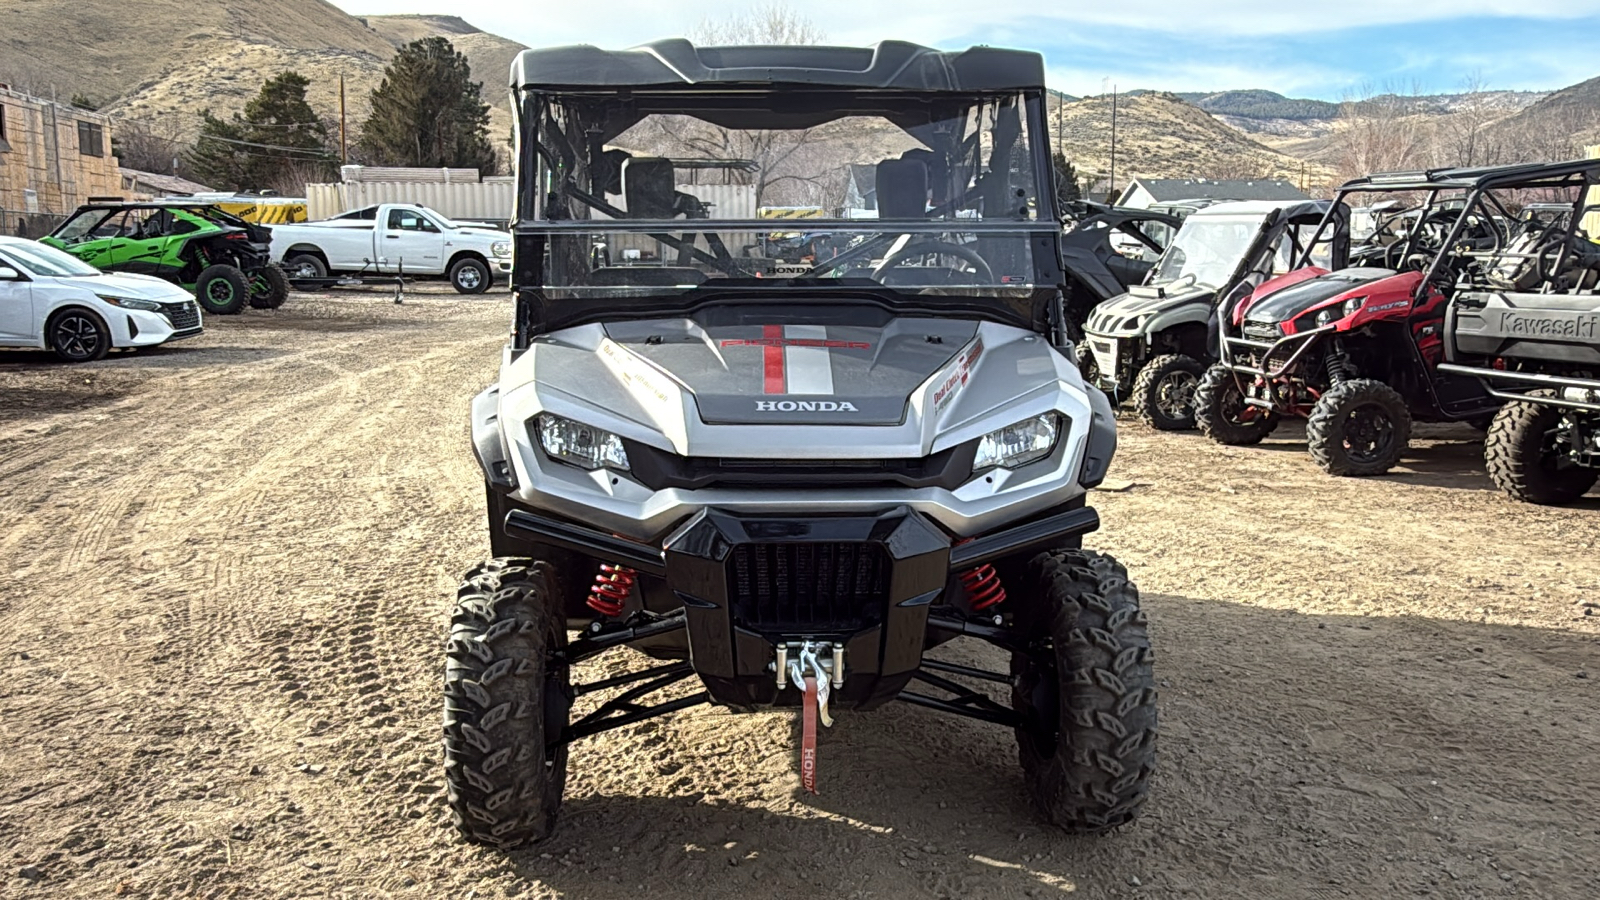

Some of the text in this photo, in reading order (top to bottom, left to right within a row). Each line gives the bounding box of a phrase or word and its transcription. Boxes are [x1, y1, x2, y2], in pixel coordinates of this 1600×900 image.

[1500, 312, 1598, 338] Kawasaki
[720, 338, 871, 349] PIONEER
[755, 400, 859, 412] HONDA
